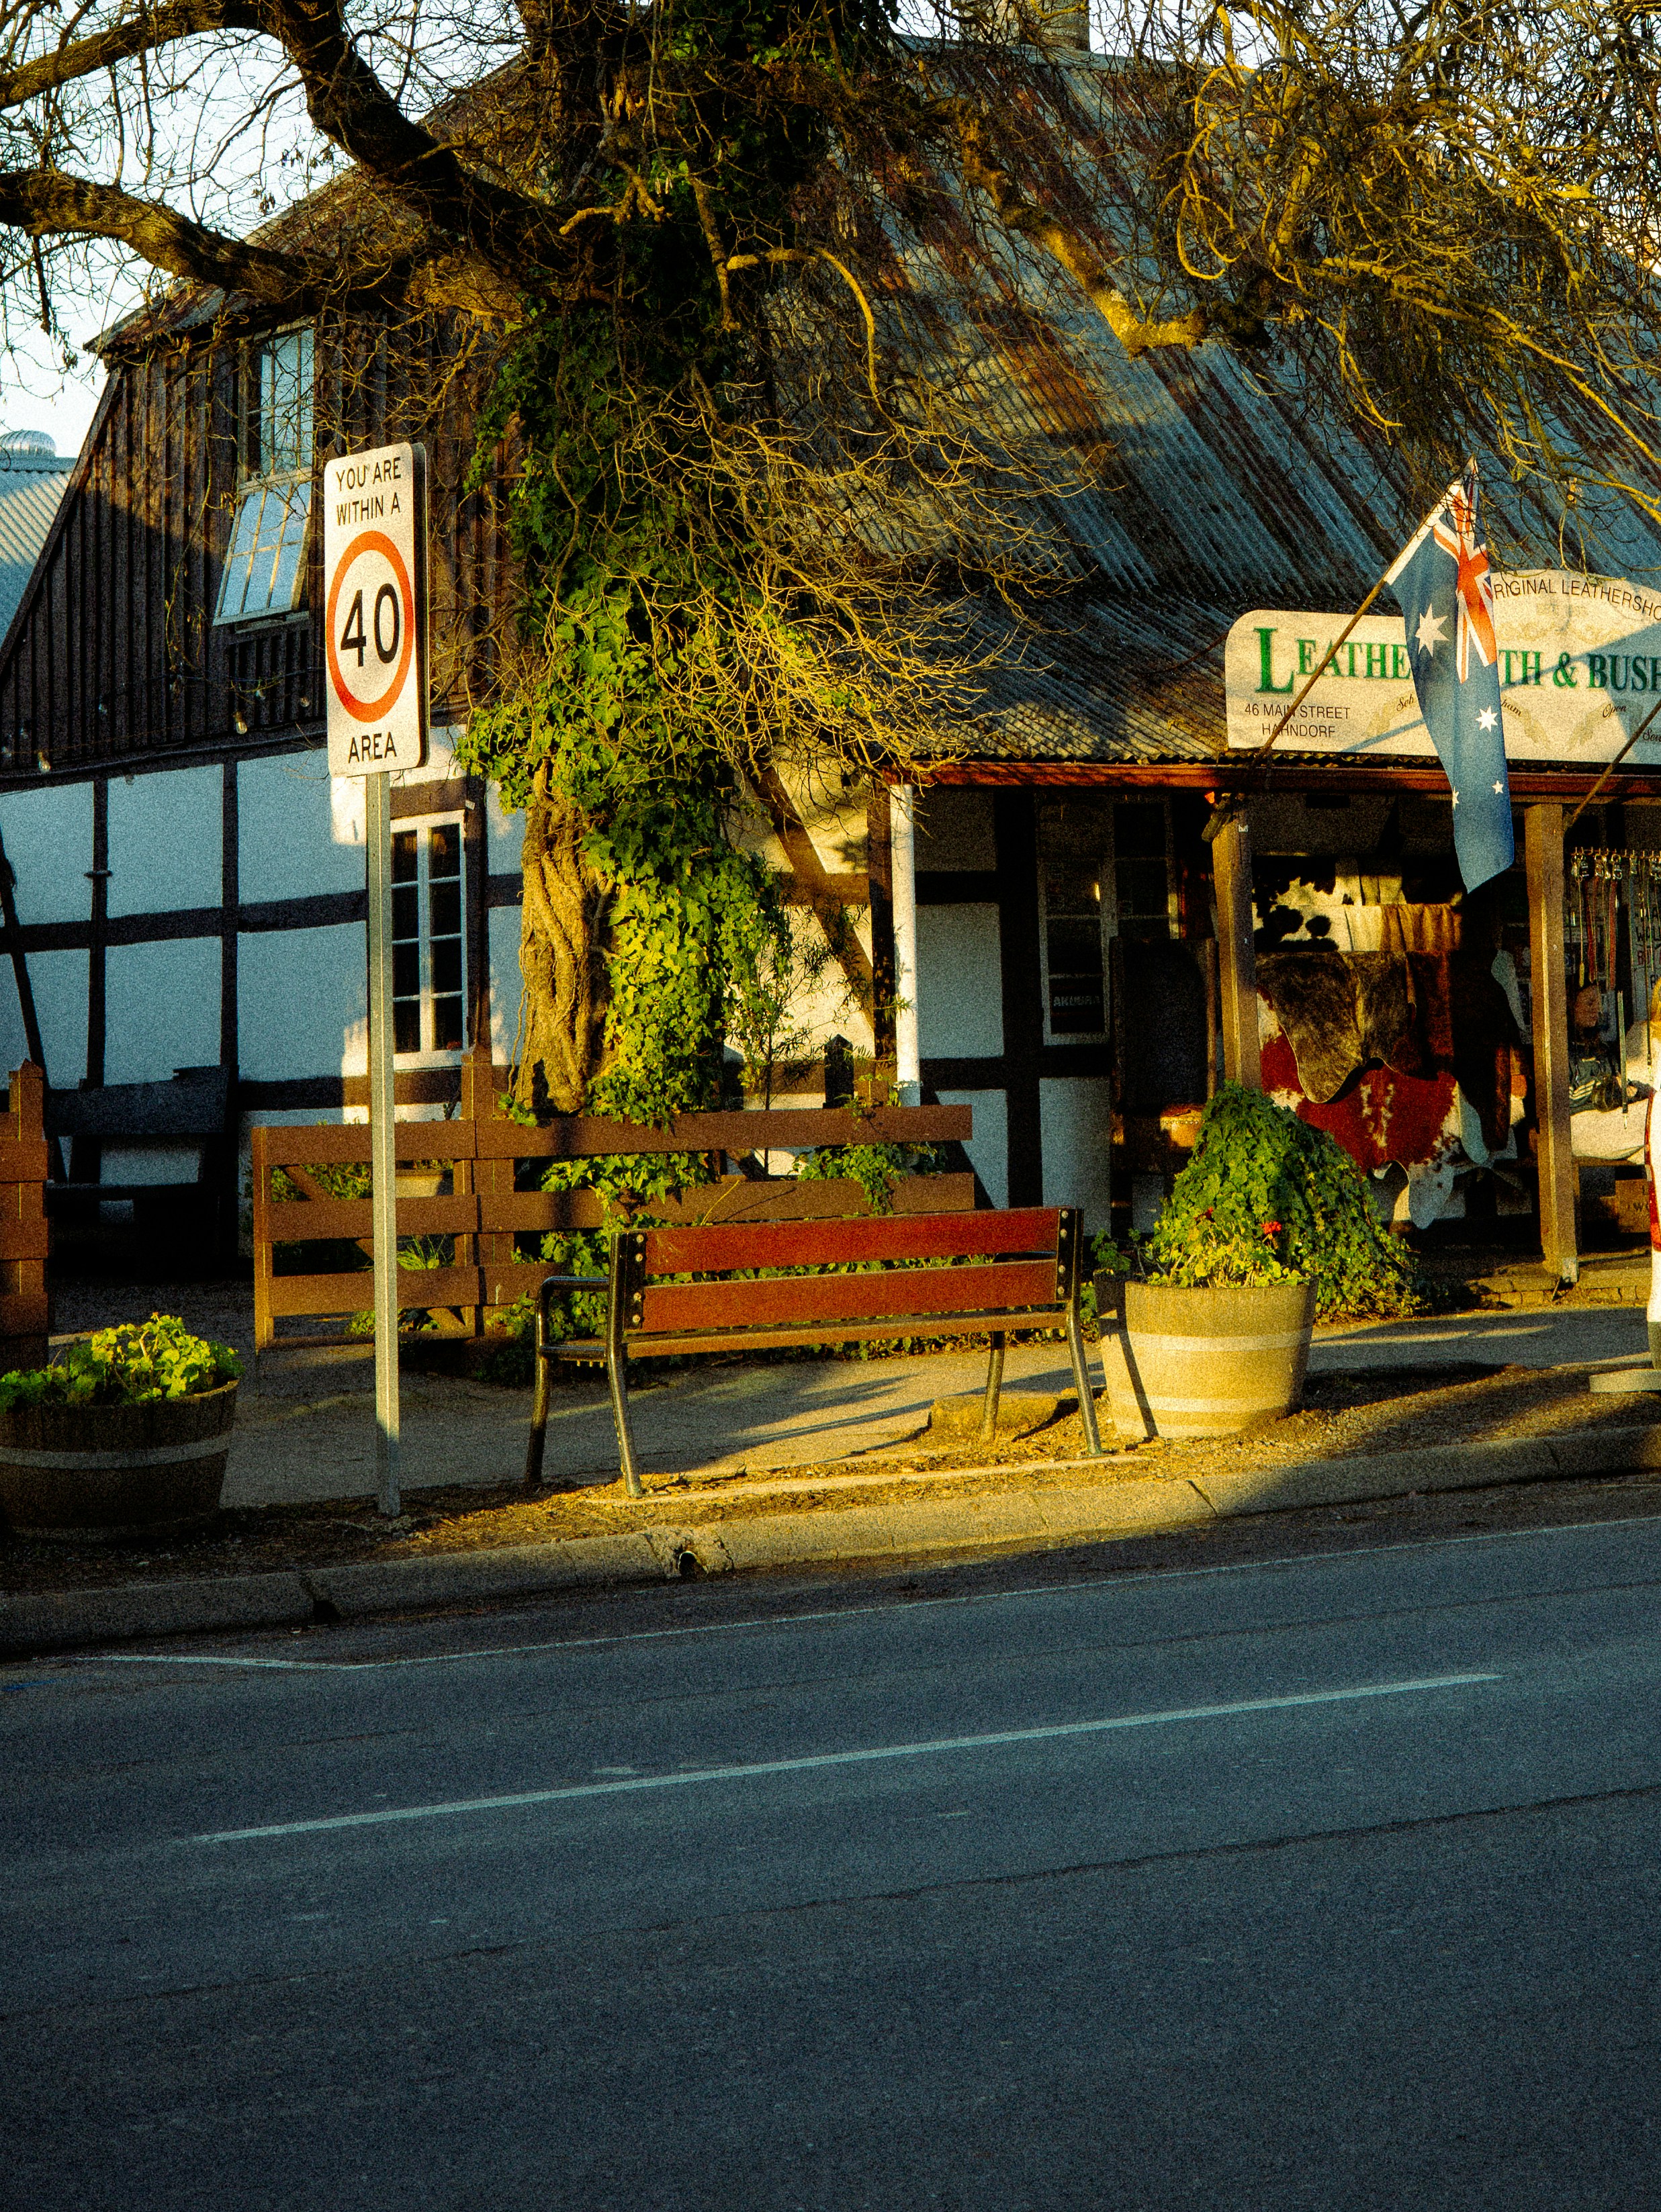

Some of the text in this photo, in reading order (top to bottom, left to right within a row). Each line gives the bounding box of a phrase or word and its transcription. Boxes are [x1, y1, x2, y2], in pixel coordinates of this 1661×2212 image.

[336, 457, 401, 492] YOU ARE
[336, 492, 400, 526] WITHIN A
[1494, 579, 1556, 600] RIGINAL
[341, 583, 400, 667] 40
[1553, 651, 1578, 688] &
[1245, 703, 1351, 719] 46 MAIN STREET
[1602, 703, 1627, 718] Open
[349, 733, 398, 764] AREA
